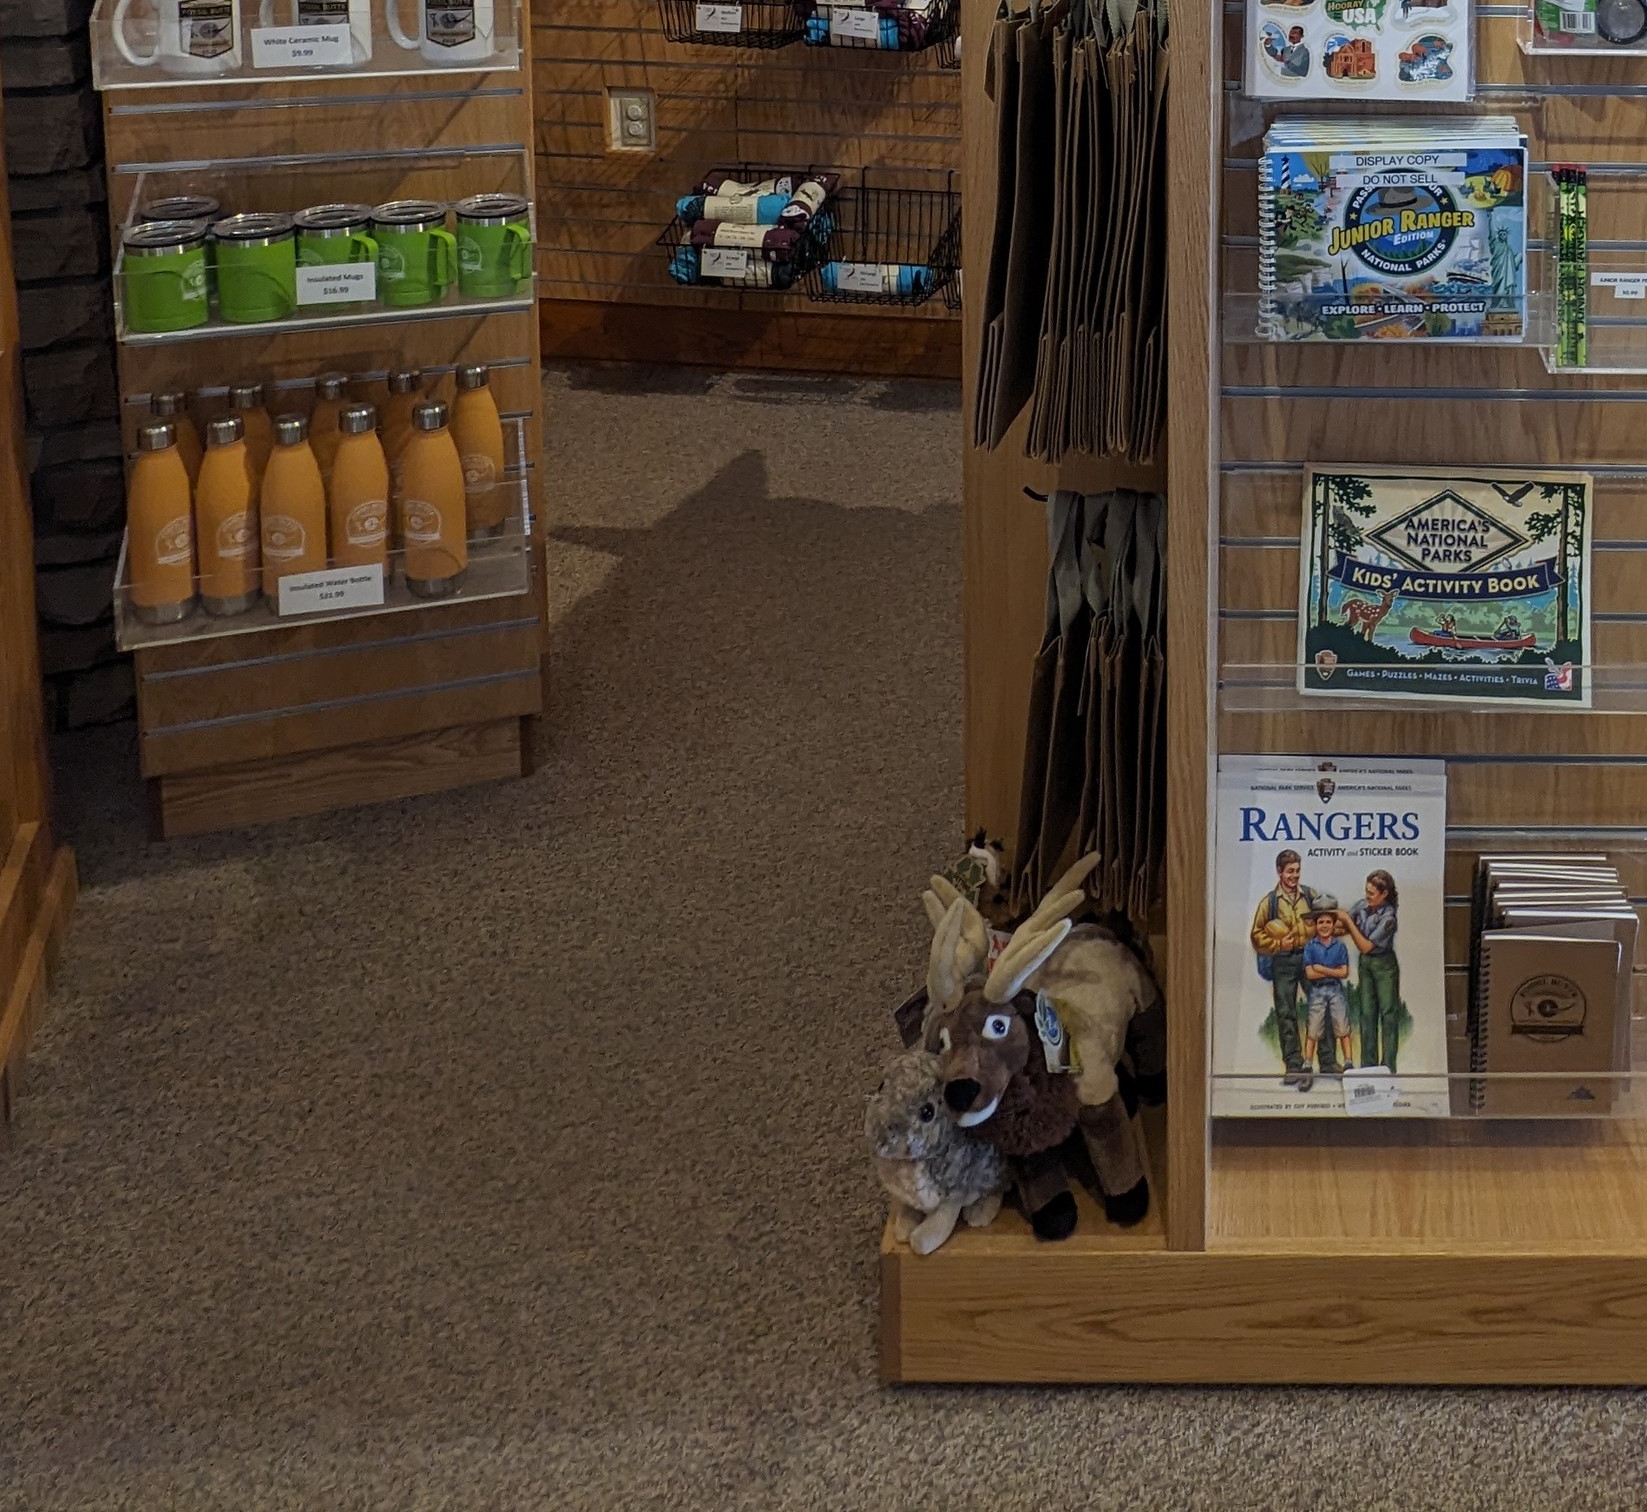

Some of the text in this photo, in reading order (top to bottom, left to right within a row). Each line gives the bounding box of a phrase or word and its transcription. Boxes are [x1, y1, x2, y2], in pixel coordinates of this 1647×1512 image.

[1327, 0, 1365, 11] HOORAY
[1342, 8, 1377, 25] USA
[264, 35, 339, 46] White Ceramic Mug
[1356, 155, 1440, 166] DISPLAY COPY
[1363, 174, 1438, 185] DO NOT SELL
[1328, 209, 1474, 255] JUNIOR RANGER
[1393, 231, 1434, 246] EDITION
[1361, 248, 1412, 272] NATIONAL
[1322, 302, 1485, 315] EXPLORE LEARN PROTECT
[1404, 518, 1491, 533] AMERICA'S
[1406, 532, 1488, 549] NATIONAL
[1421, 548, 1472, 563] PARKS
[1352, 567, 1540, 594] KIDS' ACTIVITY BOOK
[1347, 669, 1538, 685] GAMES PUZZLES MAZES ACTIVITIES TRIVIA
[1239, 807, 1420, 842] RANGERS
[1308, 848, 1346, 857] ACTIVITY
[1360, 847, 1392, 856] STICKER
[1395, 847, 1419, 856] BOOK
